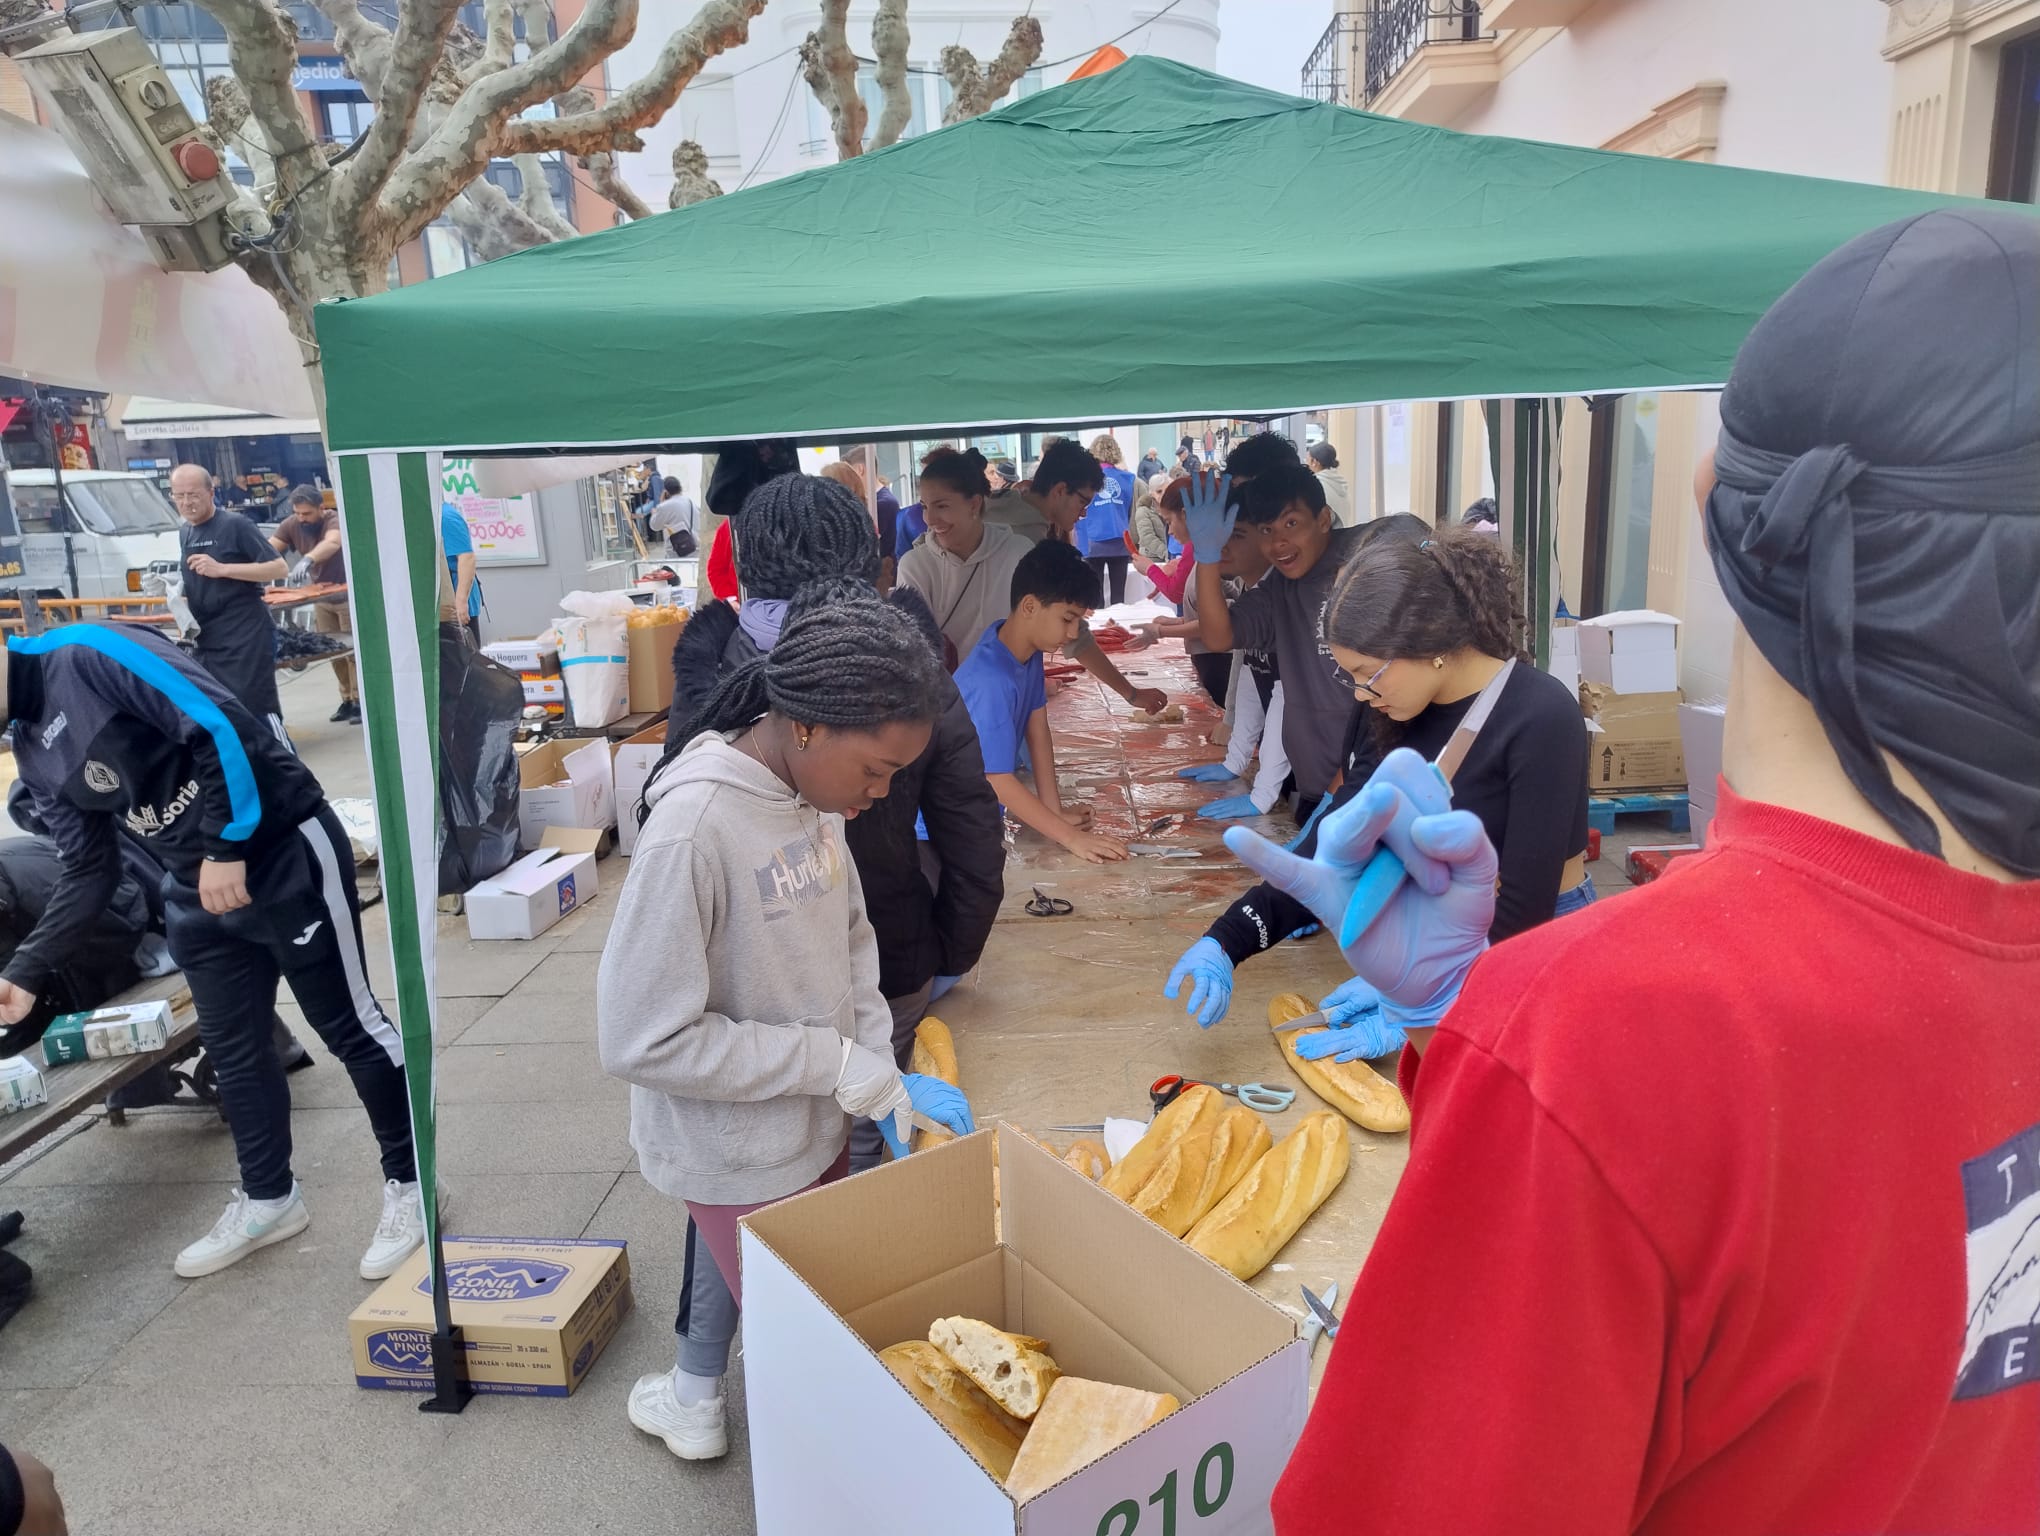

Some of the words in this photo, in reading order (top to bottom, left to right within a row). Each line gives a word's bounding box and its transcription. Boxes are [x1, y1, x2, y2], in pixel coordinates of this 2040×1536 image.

[454, 1277, 519, 1288] PINOS
[448, 1287, 520, 1298] MONTE
[387, 1332, 432, 1343] MONTE
[394, 1342, 432, 1353] PINOS
